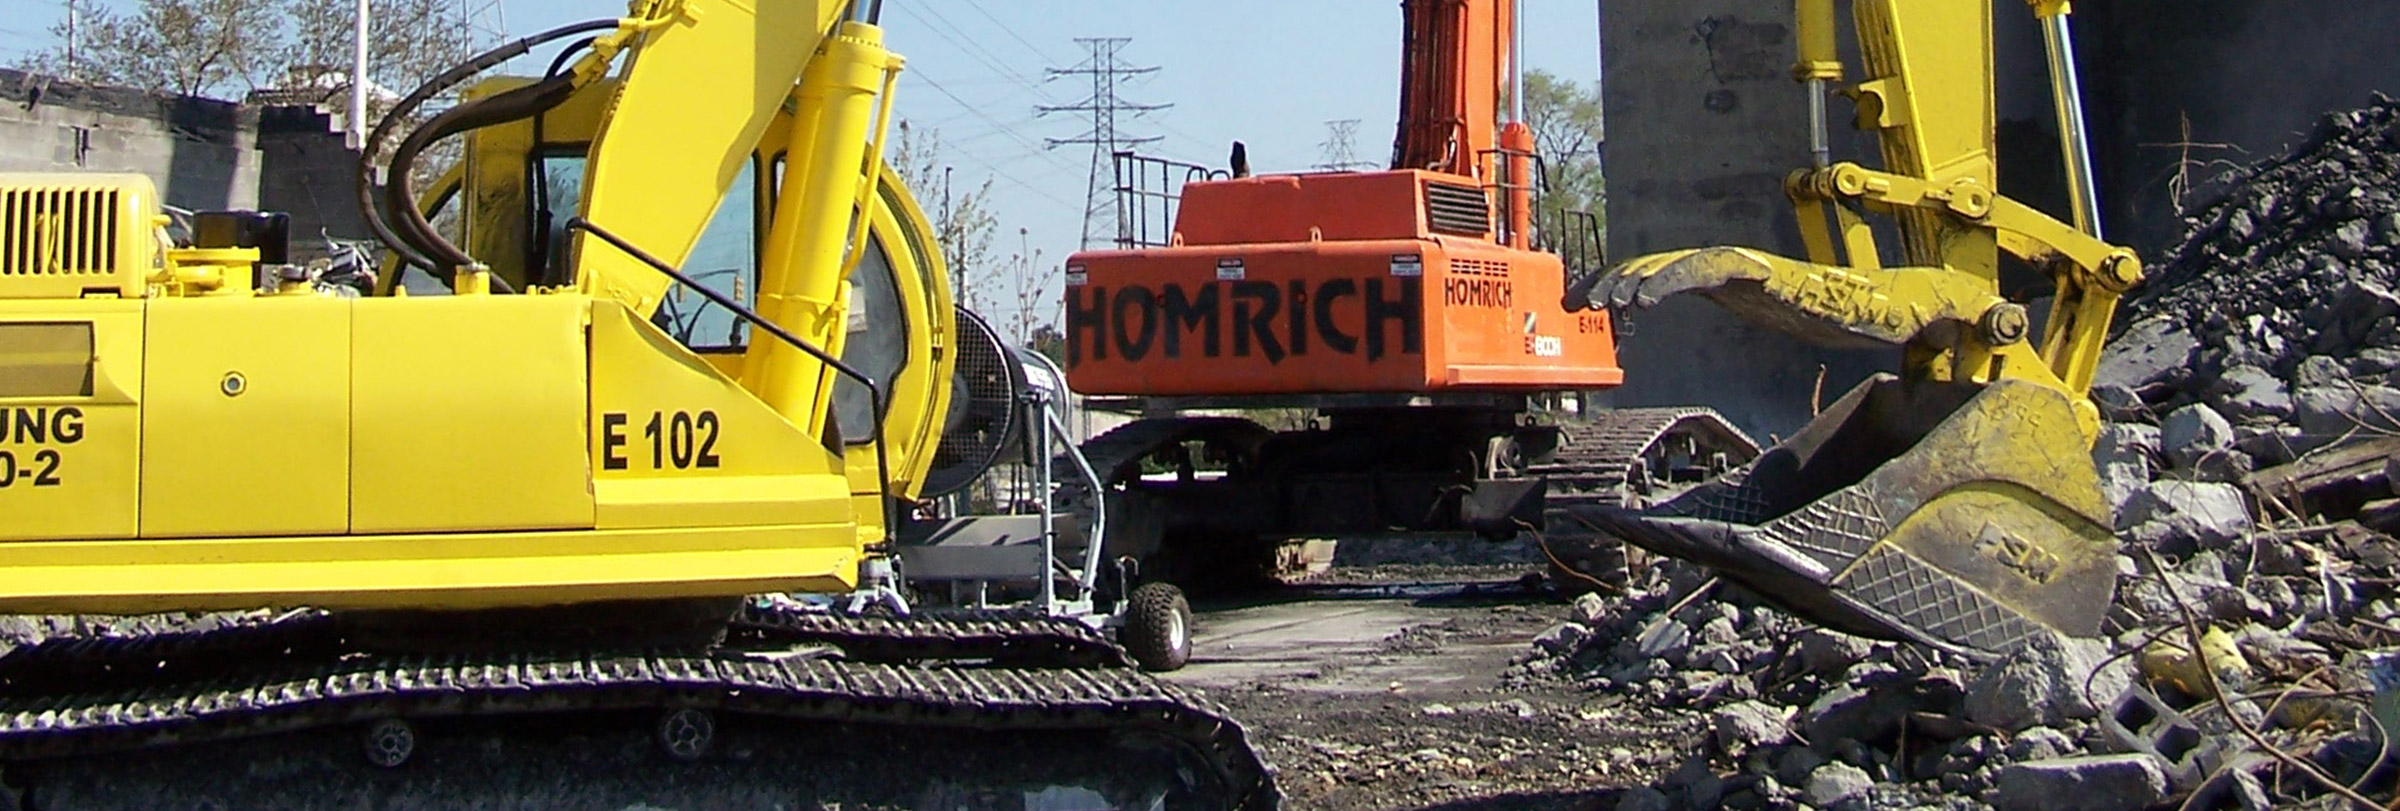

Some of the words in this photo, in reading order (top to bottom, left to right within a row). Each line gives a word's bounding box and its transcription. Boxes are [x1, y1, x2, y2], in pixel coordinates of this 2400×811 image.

[1066, 277, 1422, 368] HOMRICH
[1445, 278, 1512, 309] HOMRICH
[603, 413, 627, 470] E
[645, 410, 720, 469] 102
